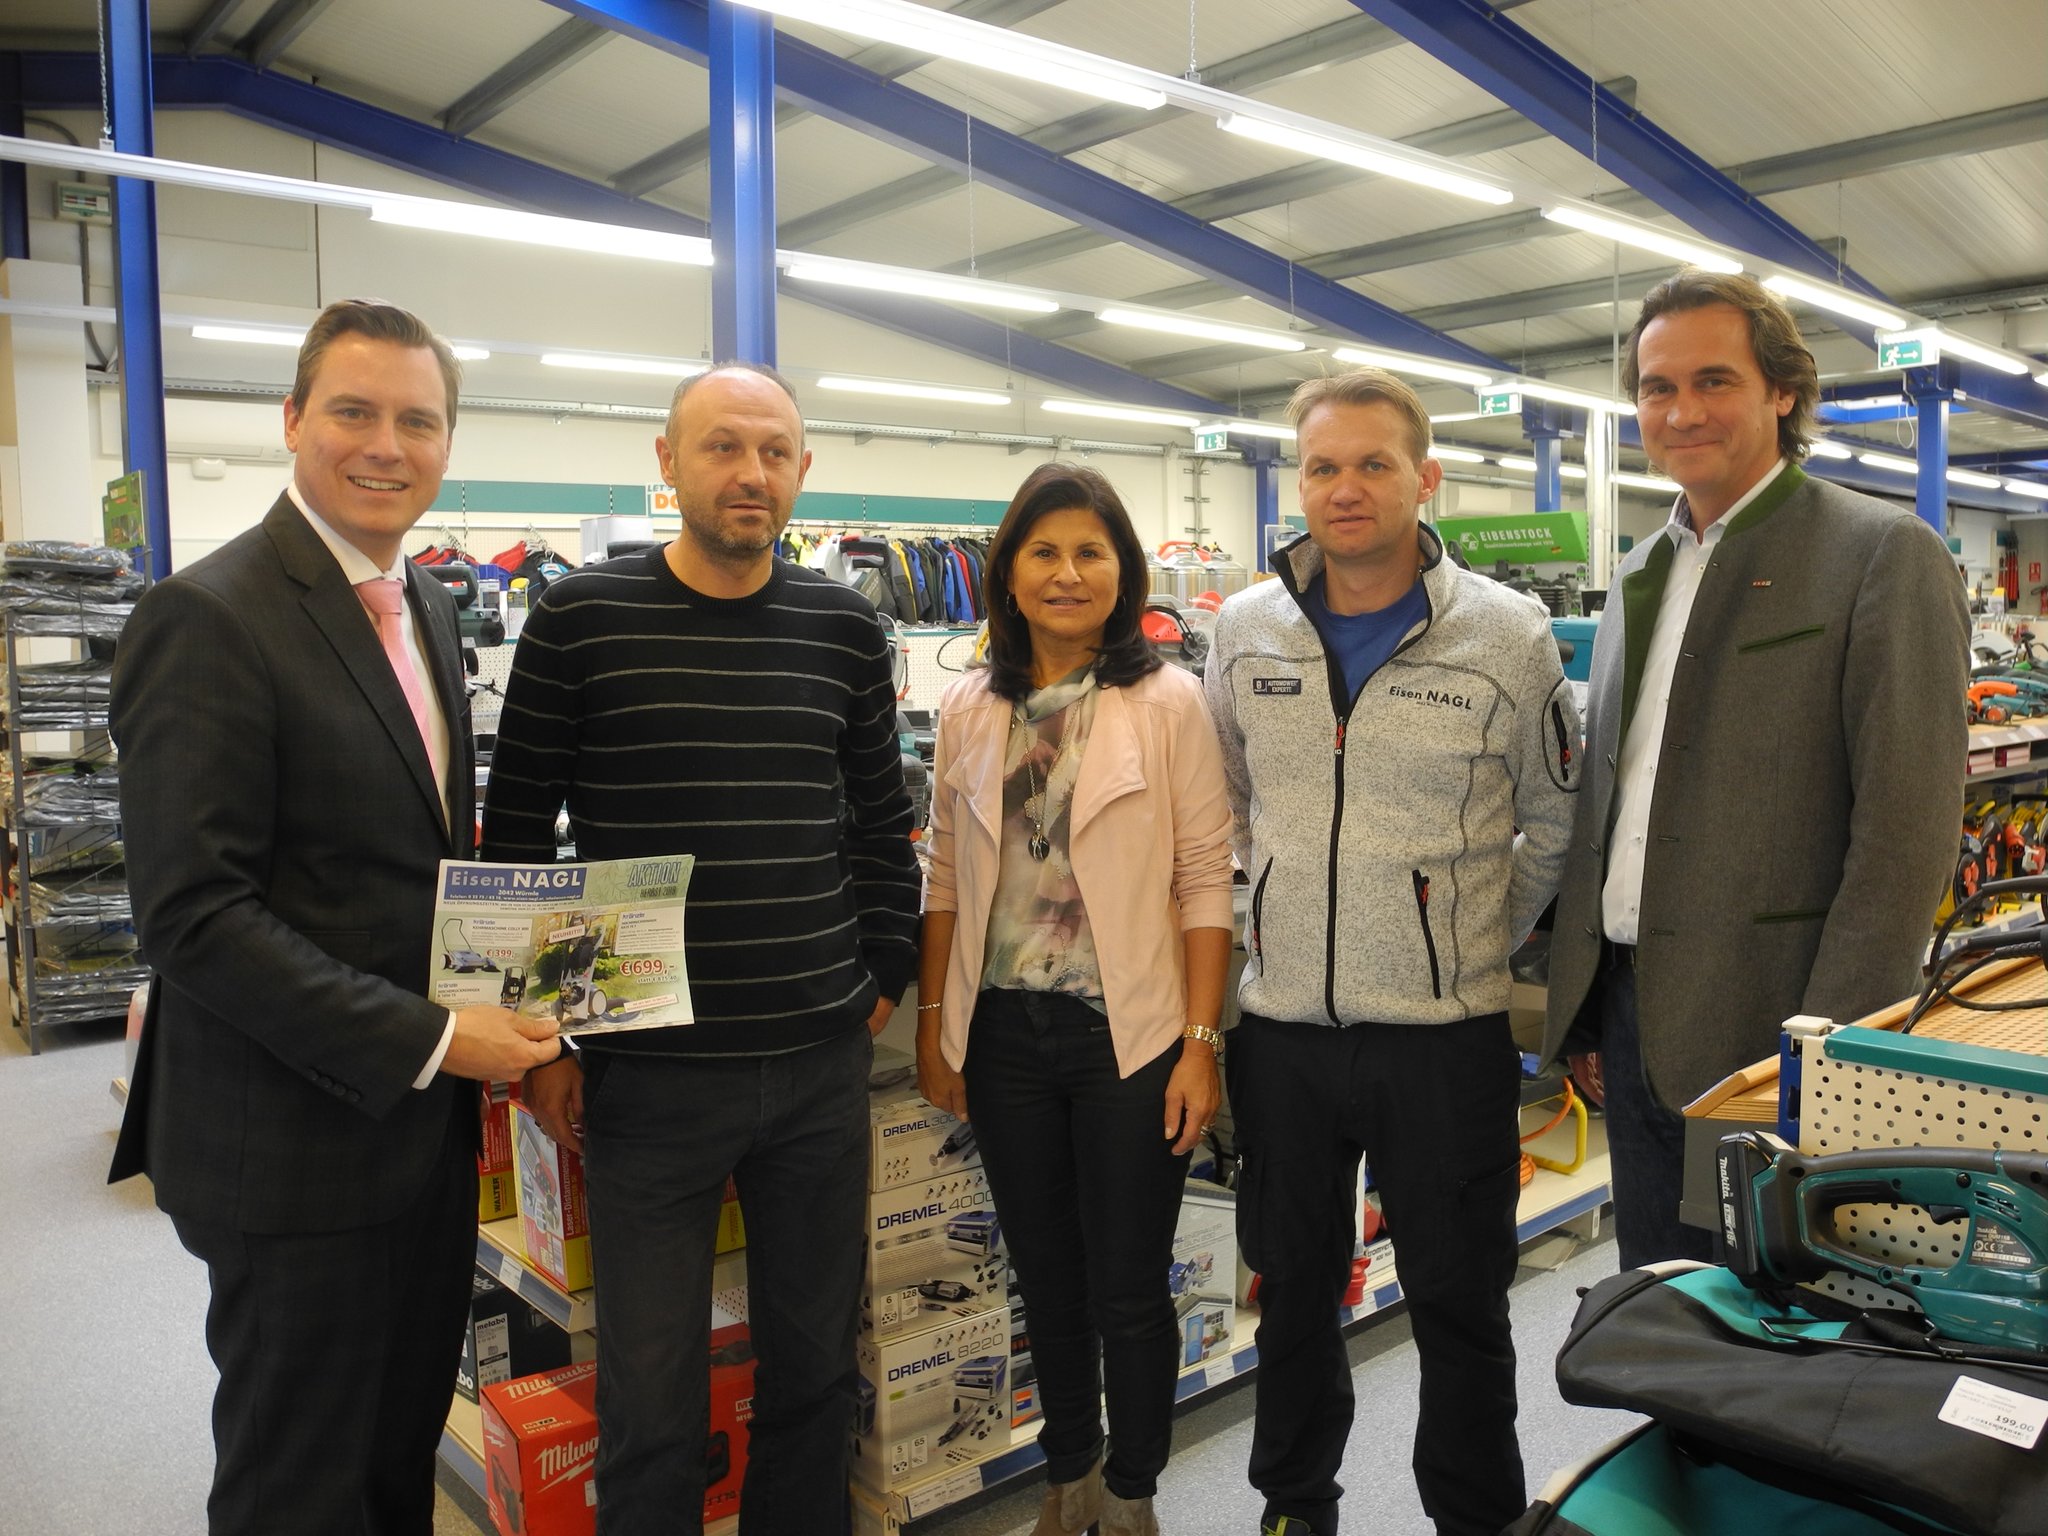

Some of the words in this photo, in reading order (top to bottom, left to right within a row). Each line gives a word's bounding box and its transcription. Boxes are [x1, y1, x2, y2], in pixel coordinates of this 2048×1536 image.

[1480, 528, 1553, 542] EIBENSTOCK
[1389, 686, 1422, 700] Eisen
[1427, 690, 1472, 710] NAGL
[451, 871, 505, 887] Eisen
[513, 870, 581, 888] NAGL
[627, 861, 682, 888] AKTION
[883, 1120, 931, 1138] DREMEL
[1720, 1157, 1731, 1200] makita
[492, 1176, 501, 1214] WALTER
[877, 1203, 947, 1230] DREMEL
[886, 1296, 892, 1304] 6
[902, 1290, 917, 1300] 128
[477, 1317, 506, 1331] metabo
[888, 1352, 955, 1382] DREMEL
[958, 1333, 1004, 1359] 8220
[1995, 1415, 2035, 1433] 199,00
[897, 1445, 903, 1454] 5
[914, 1437, 925, 1447] 65
